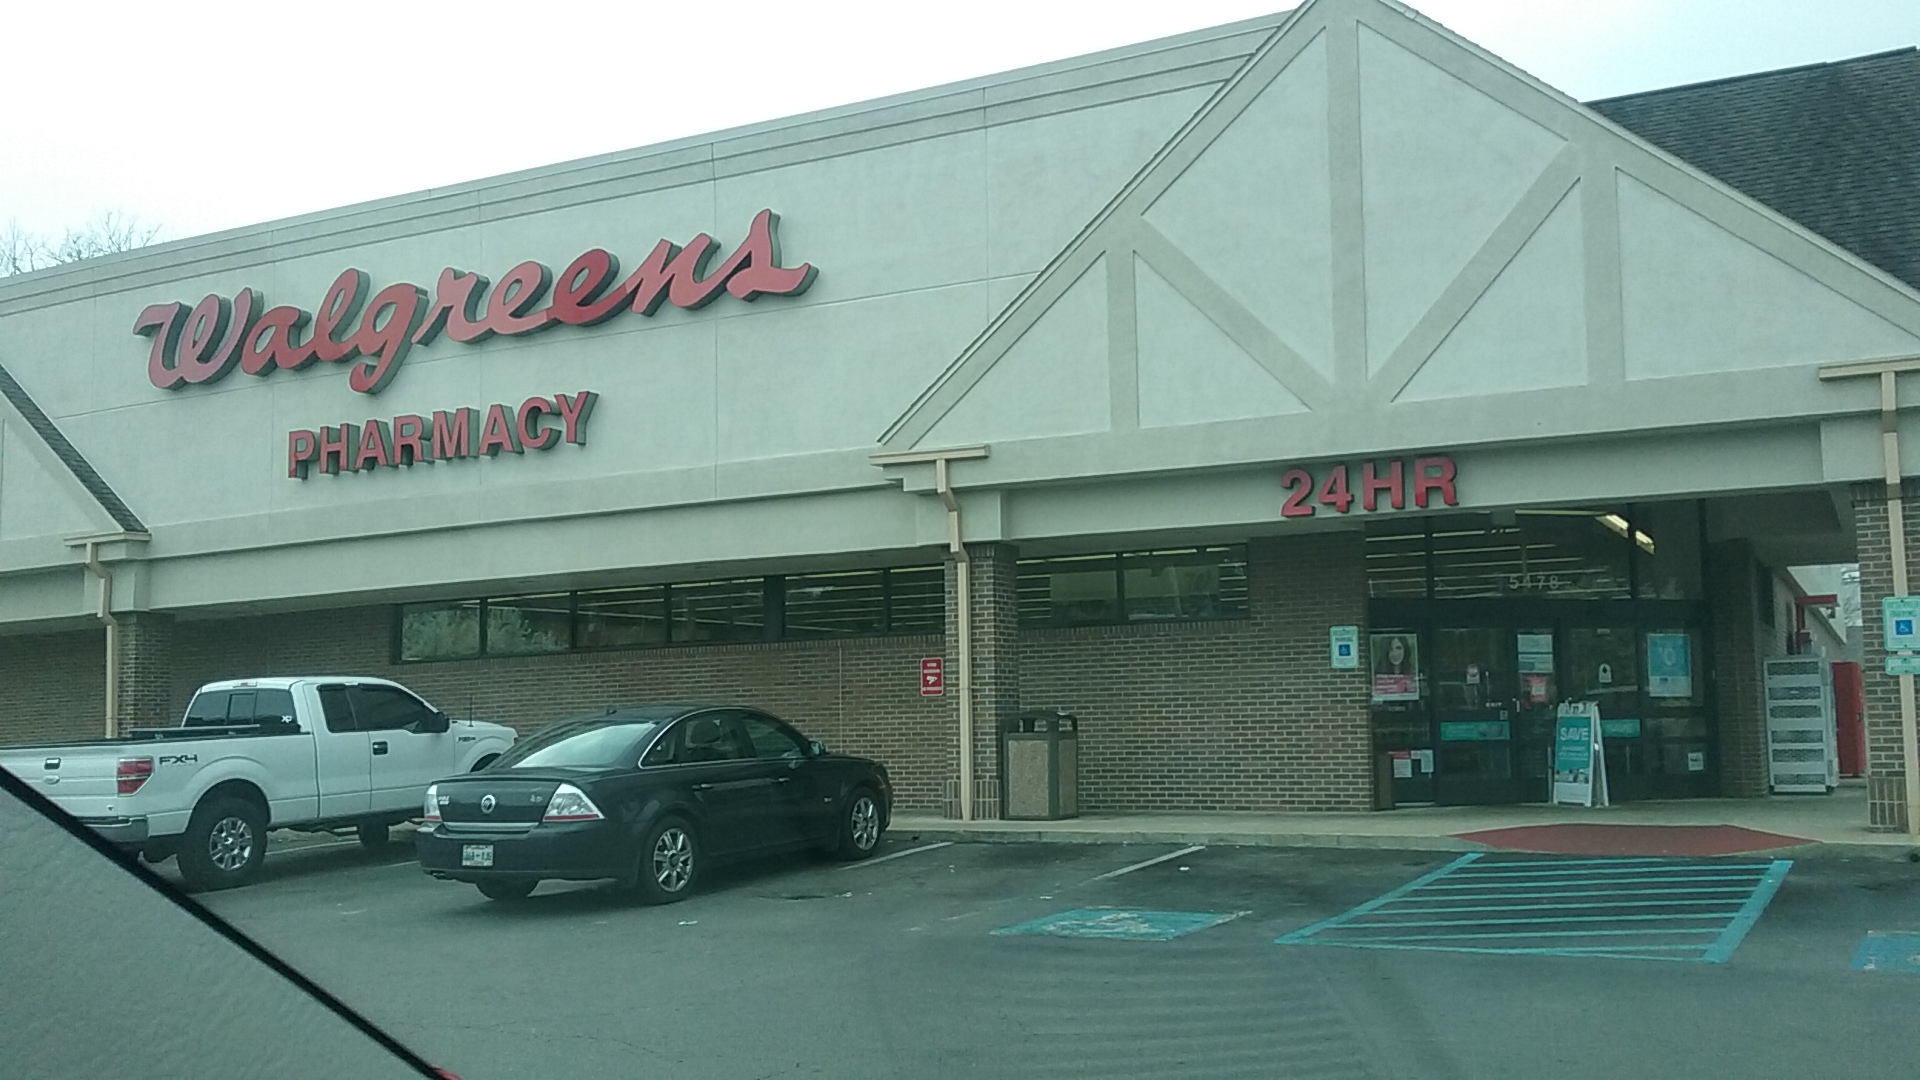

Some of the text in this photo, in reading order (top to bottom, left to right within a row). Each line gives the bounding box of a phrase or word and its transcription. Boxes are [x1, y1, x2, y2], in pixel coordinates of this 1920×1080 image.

[133, 208, 817, 394] Walgreens
[288, 390, 598, 479] PHARMACY
[1509, 574, 1559, 590] 5478
[1560, 727, 1589, 741] SAVE
[159, 754, 198, 765] FX4
